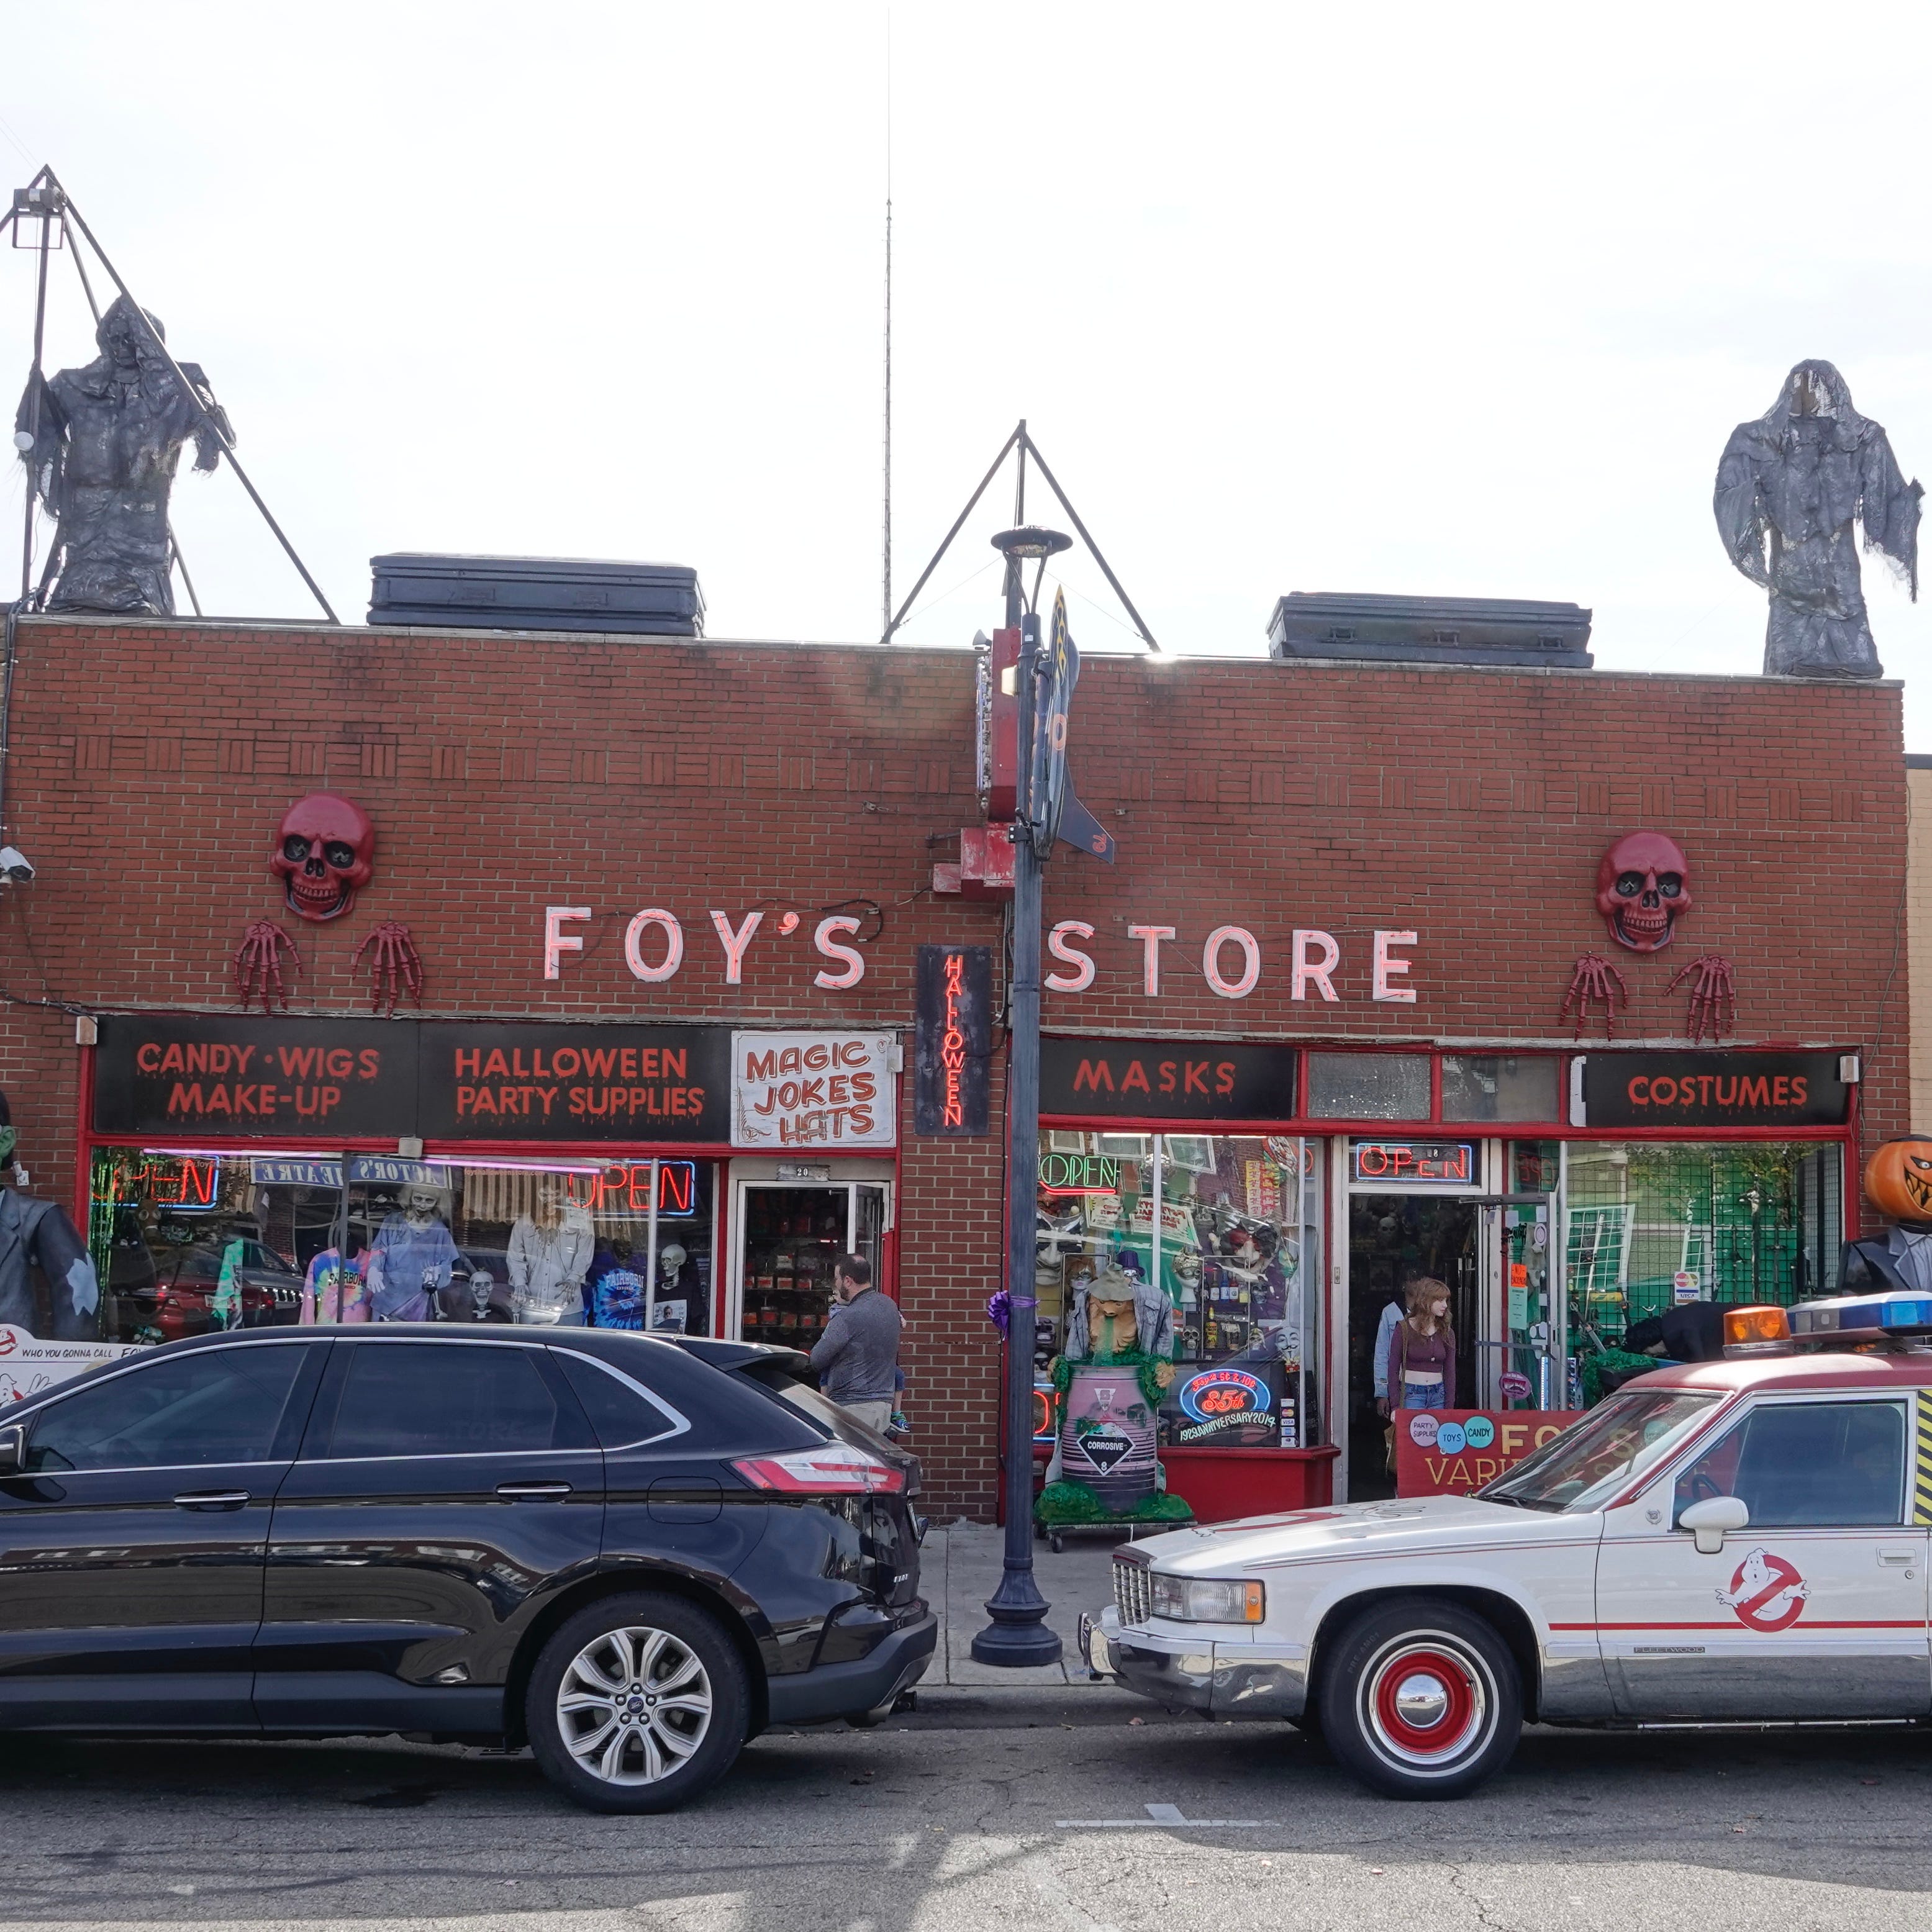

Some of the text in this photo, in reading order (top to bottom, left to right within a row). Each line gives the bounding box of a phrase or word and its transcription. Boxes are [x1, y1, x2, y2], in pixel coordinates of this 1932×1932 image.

[544, 906, 1418, 1004] FOY'S STORE
[943, 955, 966, 1127] HALLOWEEN
[137, 1043, 380, 1078] CANDY WIGS
[455, 1048, 687, 1079] HALLOWEEN
[746, 1040, 871, 1082] MAGIC
[1073, 1059, 1236, 1095] MASKS
[1628, 1075, 1808, 1107] COSTUMES
[167, 1083, 342, 1116] MAKE-UP
[456, 1086, 705, 1117] PARTY SUPPLIES
[754, 1072, 877, 1115] JOKES
[779, 1104, 874, 1146] HATS
[797, 1168, 808, 1176] 20
[1040, 1154, 1117, 1187] OPEN
[1361, 1147, 1466, 1177] OPEN
[605, 1272, 644, 1289] FAIRBORN
[22, 1348, 43, 1358] WHO
[45, 1349, 61, 1358] YOU
[62, 1349, 91, 1358] GONNA
[93, 1349, 112, 1358] CALL
[1202, 1389, 1248, 1413] 85th
[1087, 1440, 1124, 1451] CORROSIVE
[1443, 1433, 1461, 1442] TOYS
[1467, 1428, 1491, 1438] CANDY
[1100, 1461, 1108, 1471] 8
